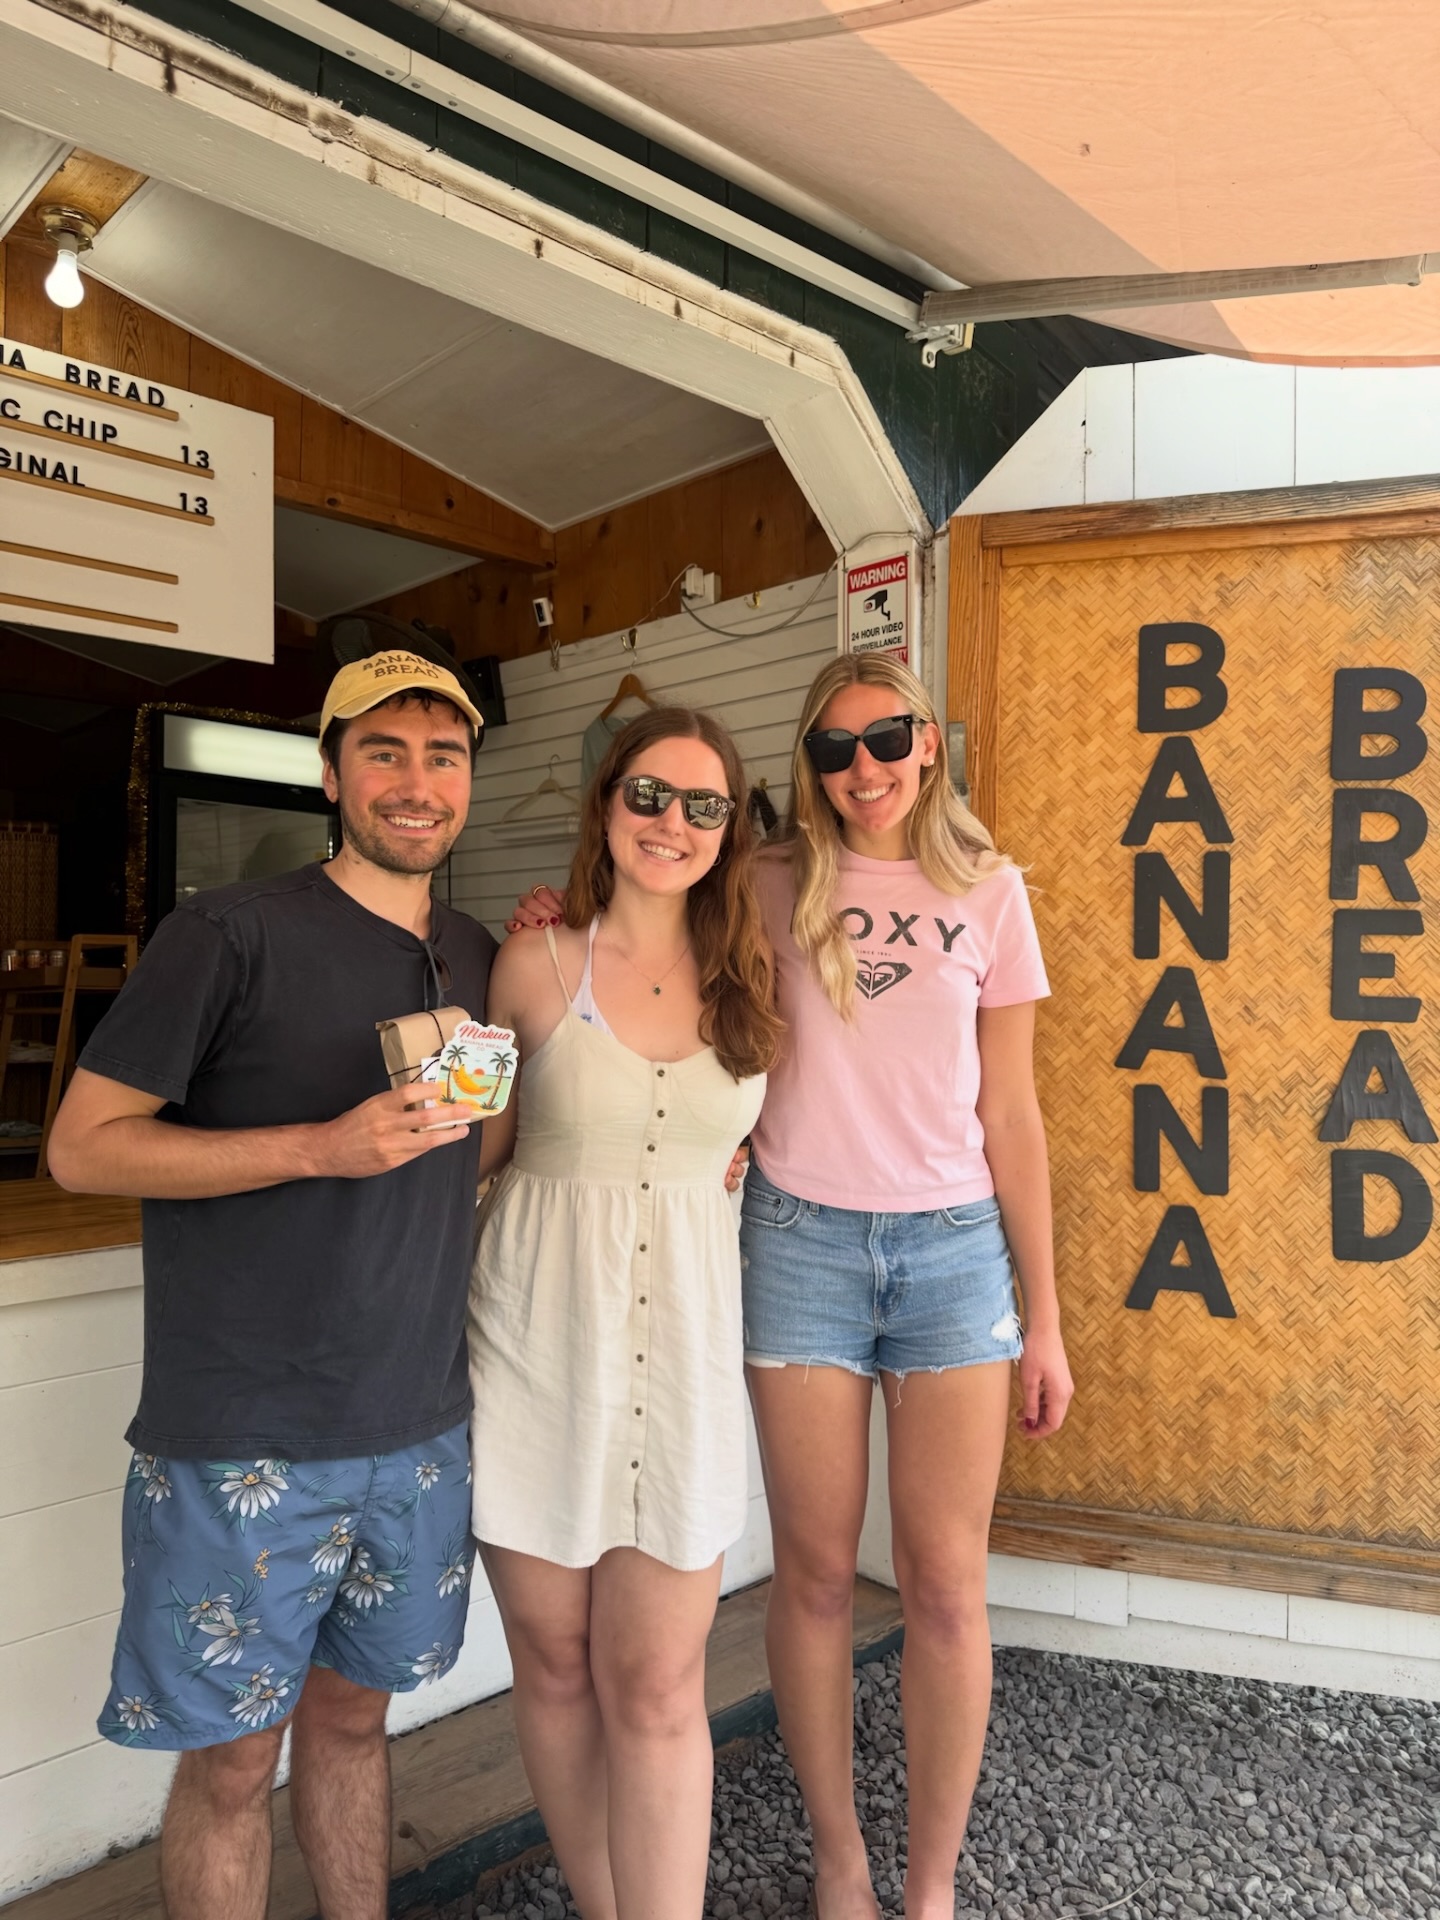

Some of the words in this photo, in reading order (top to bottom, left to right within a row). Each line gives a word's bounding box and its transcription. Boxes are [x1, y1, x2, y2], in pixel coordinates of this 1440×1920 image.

[65, 363, 165, 408] BREAD
[43, 410, 118, 443] CHIP
[180, 445, 210, 469] 13
[179, 493, 208, 517] 13
[849, 561, 906, 590] WARNING
[851, 632, 860, 641] 24
[861, 627, 880, 639] HOUR
[881, 621, 904, 634] VIDEO
[852, 635, 902, 653] SURVEILLANCE
[363, 655, 443, 673] BANANA
[374, 664, 439, 679] BREAD
[1114, 622, 1237, 1319] BANANA
[1318, 667, 1440, 1262] BREAD
[459, 1024, 511, 1040] Makua
